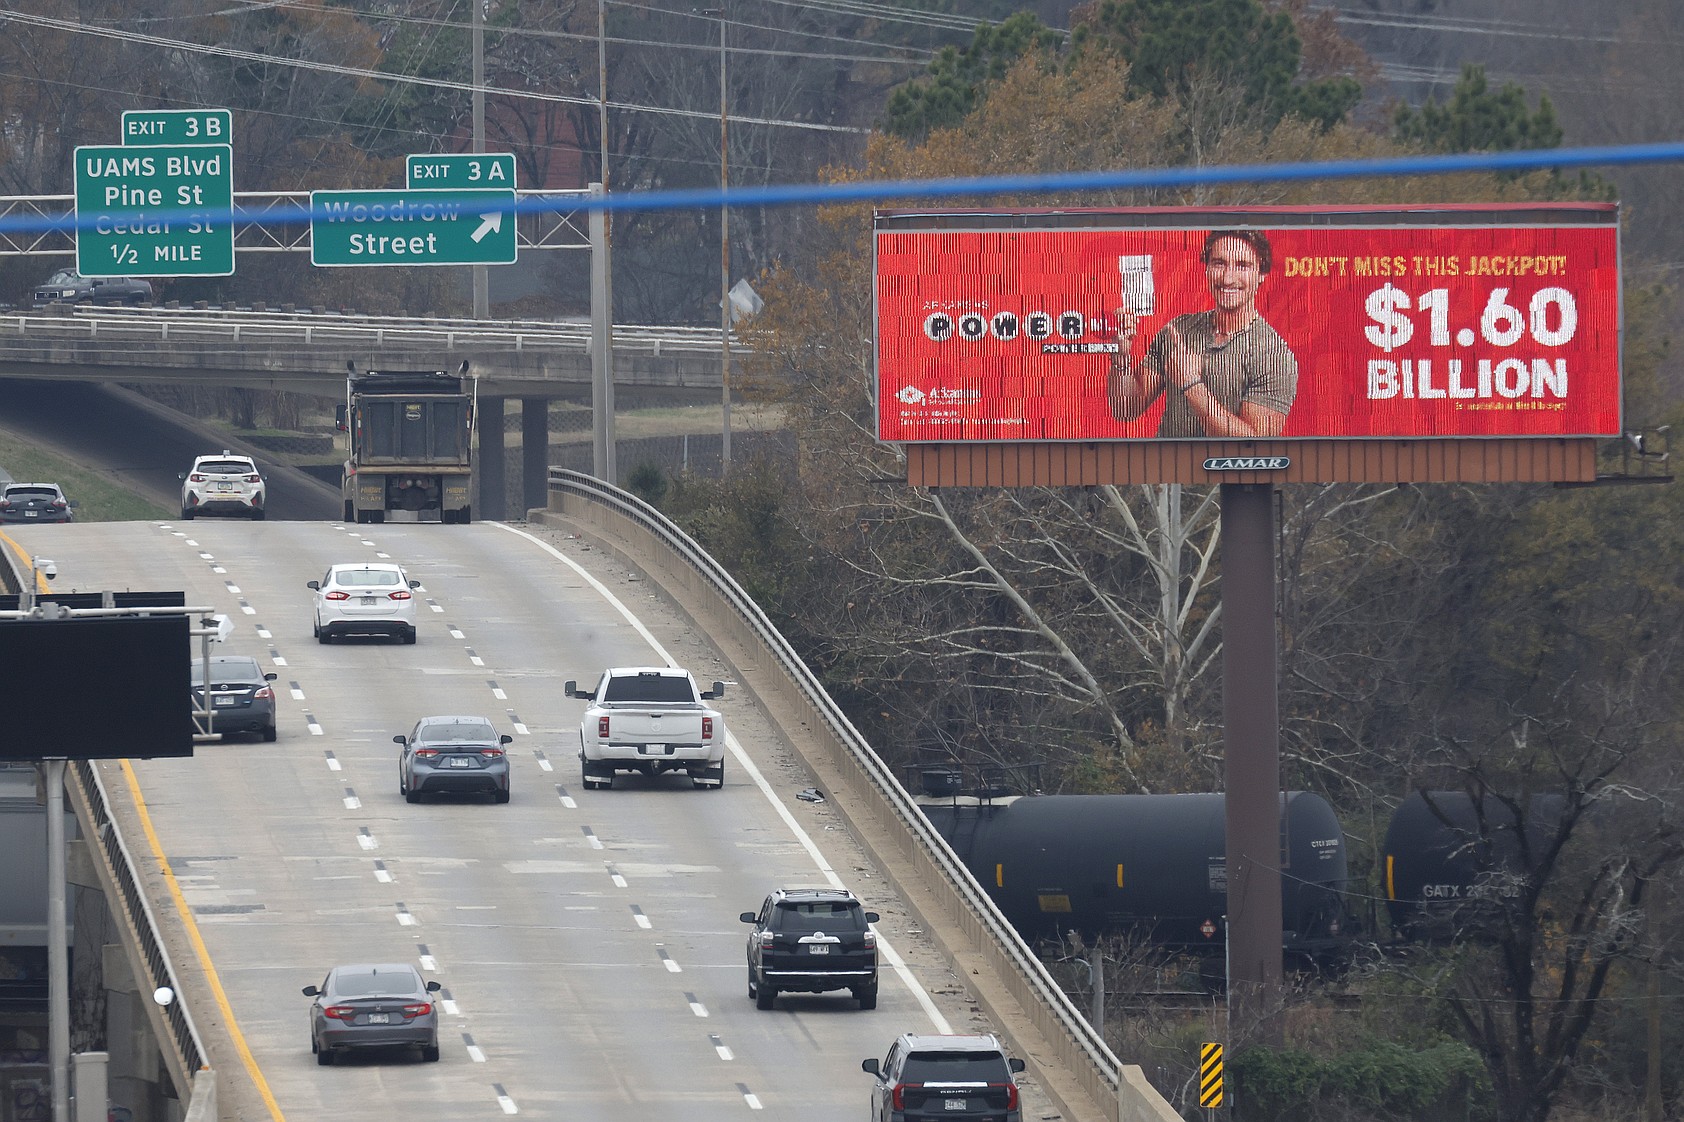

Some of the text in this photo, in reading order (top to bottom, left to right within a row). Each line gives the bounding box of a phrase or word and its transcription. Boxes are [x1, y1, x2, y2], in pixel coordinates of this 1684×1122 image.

[128, 121, 166, 135] EXIT
[86, 155, 221, 177] UAMS Blvd
[413, 164, 450, 179] EXIT
[105, 184, 203, 206] Pine St
[324, 200, 460, 222] Woodrow
[154, 246, 202, 262] MILE
[350, 233, 437, 255] Street
[1285, 255, 1566, 276] DON'T MISS THIS JACKPOT!
[929, 314, 1083, 338] POWER
[1364, 282, 1578, 352] $1.60
[1367, 358, 1567, 399] BILLION
[1210, 459, 1281, 469] LAMAR
[1423, 884, 1459, 898] GATX
